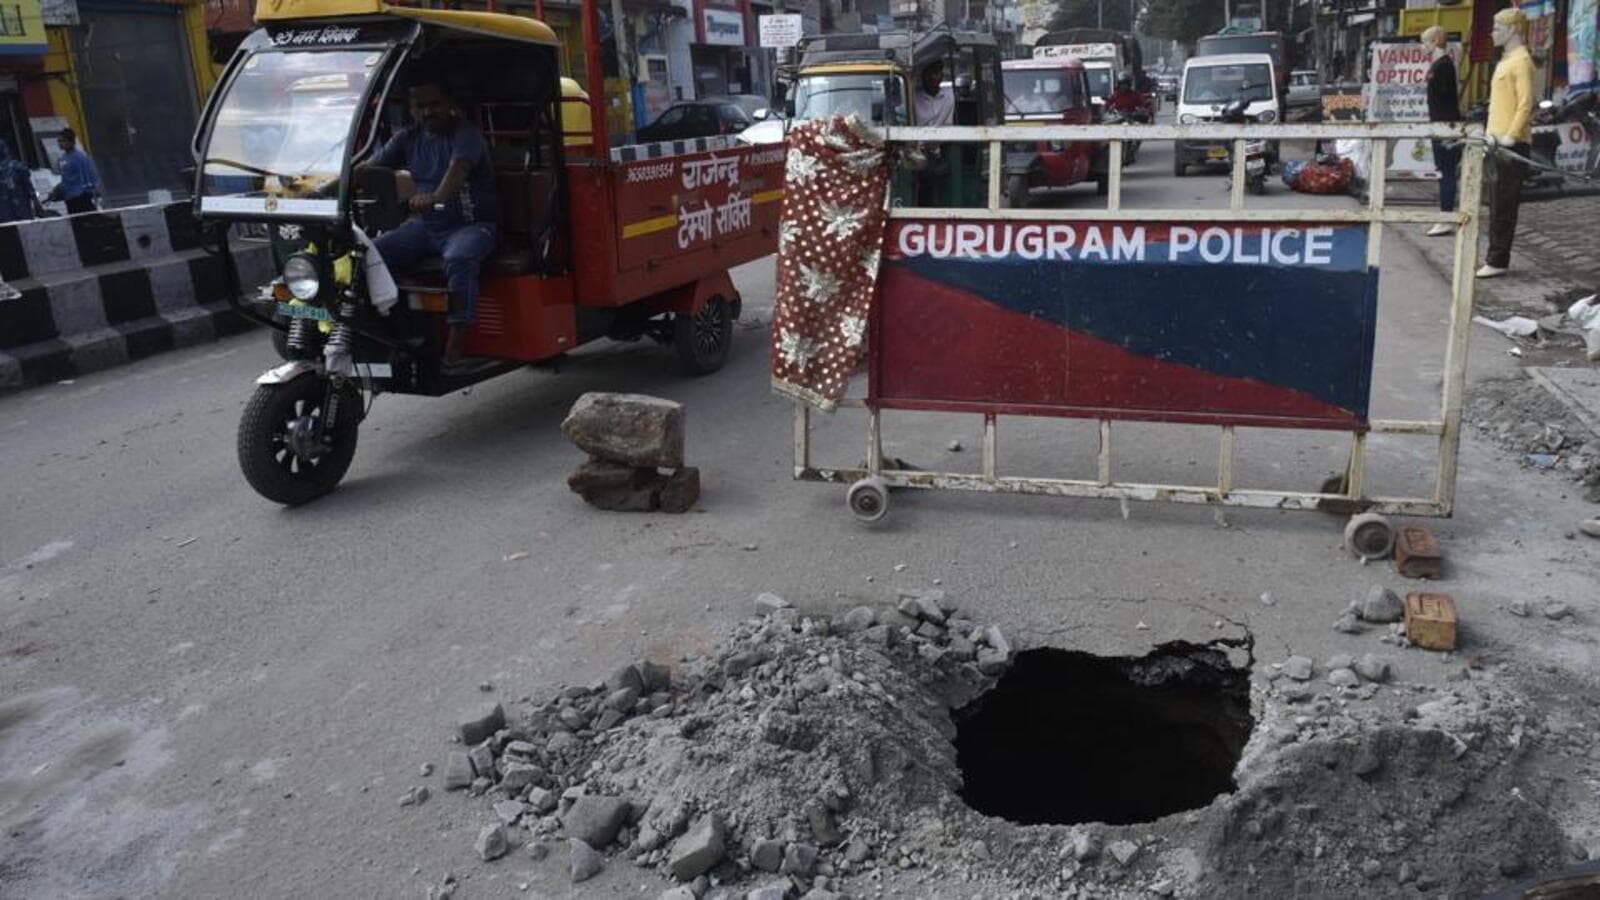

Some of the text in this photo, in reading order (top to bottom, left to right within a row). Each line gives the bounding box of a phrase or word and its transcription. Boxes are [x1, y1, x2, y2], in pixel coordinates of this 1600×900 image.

[1375, 69, 1435, 84] OPTICA
[681, 153, 741, 189] राजेन्द्र
[677, 191, 752, 249] टेम्पो सर्विस
[898, 223, 1335, 265] GURUGRAM POLICE
